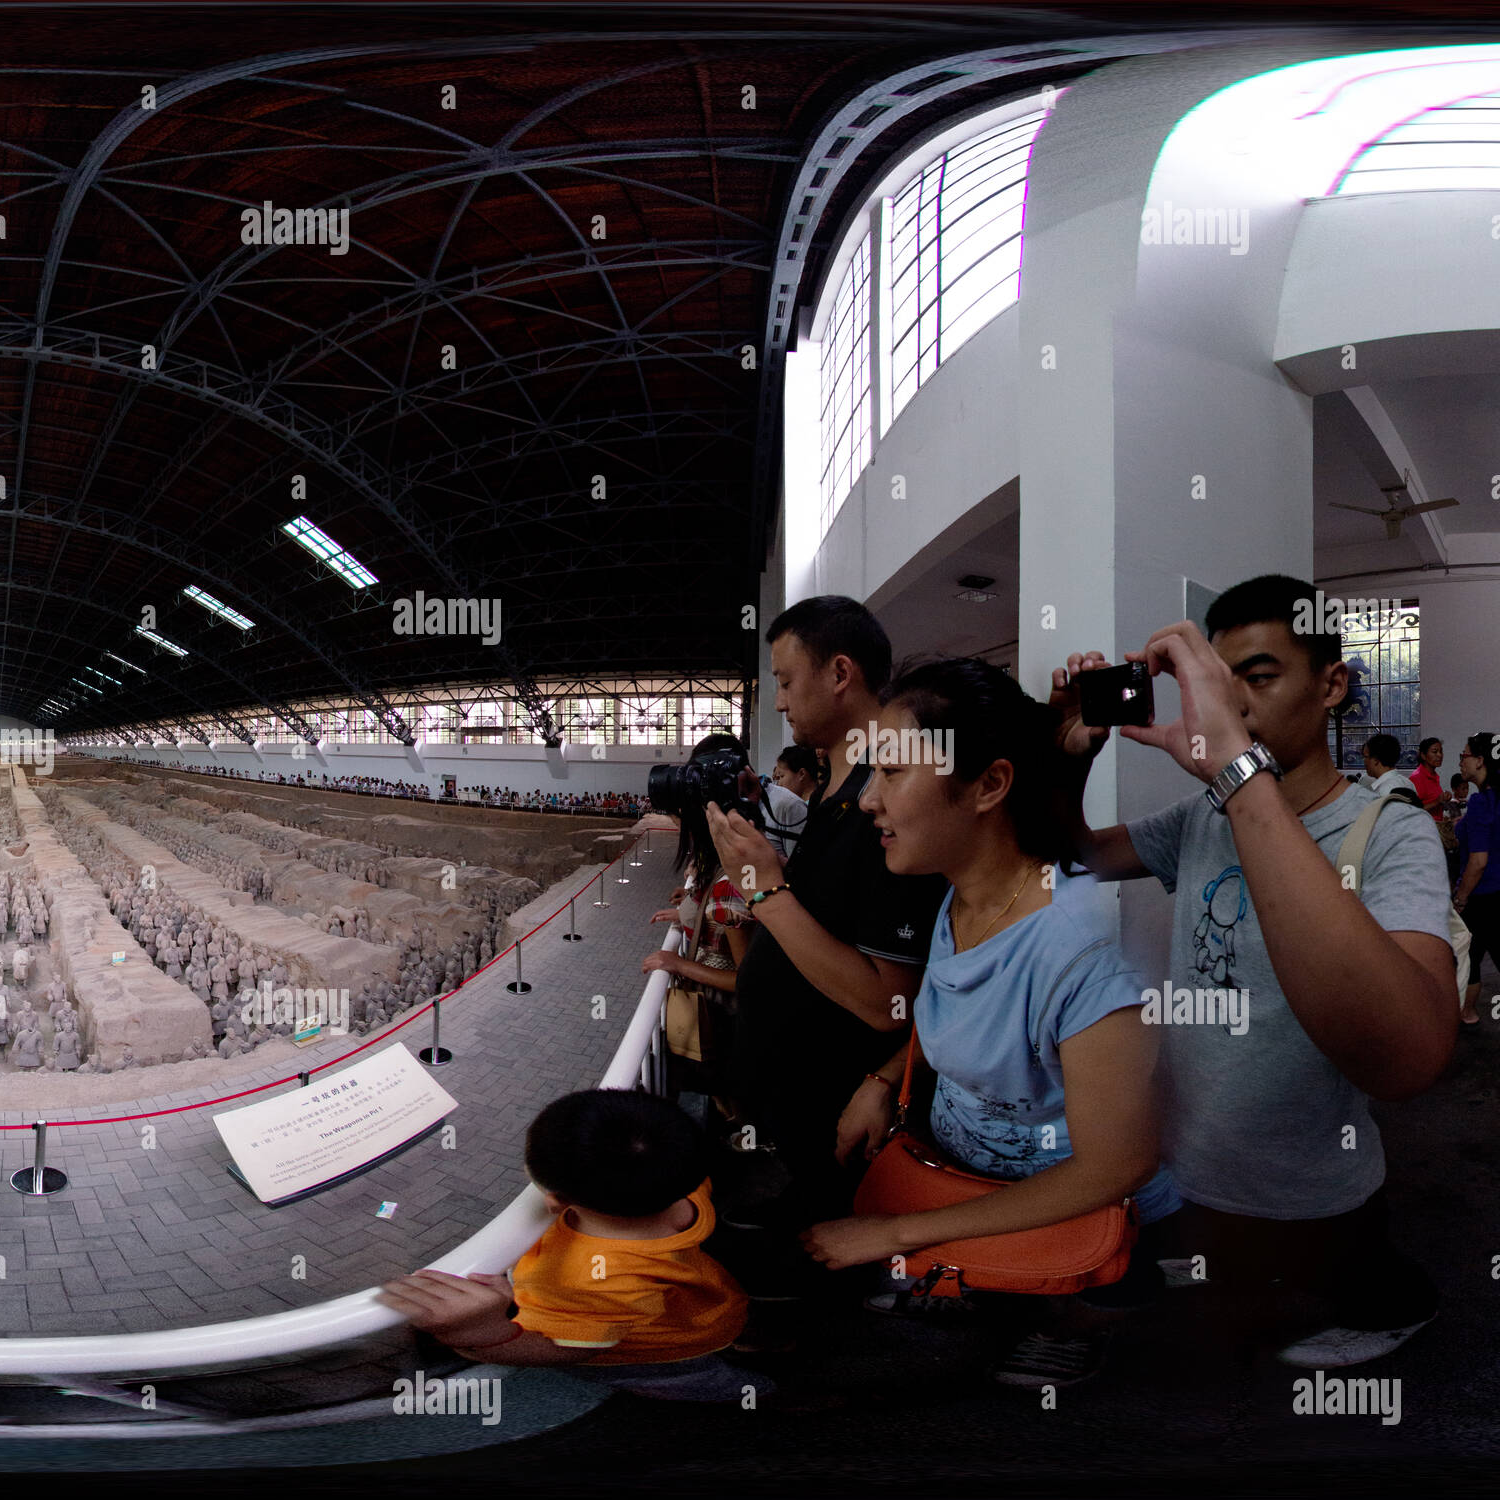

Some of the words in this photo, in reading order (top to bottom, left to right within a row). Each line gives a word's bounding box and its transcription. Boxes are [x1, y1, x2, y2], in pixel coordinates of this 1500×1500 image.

[299, 1017, 317, 1031] 22
[301, 1079, 358, 1106] 一号坑的兵器
[319, 1131, 333, 1139] The
[332, 1117, 363, 1133] Weapons
